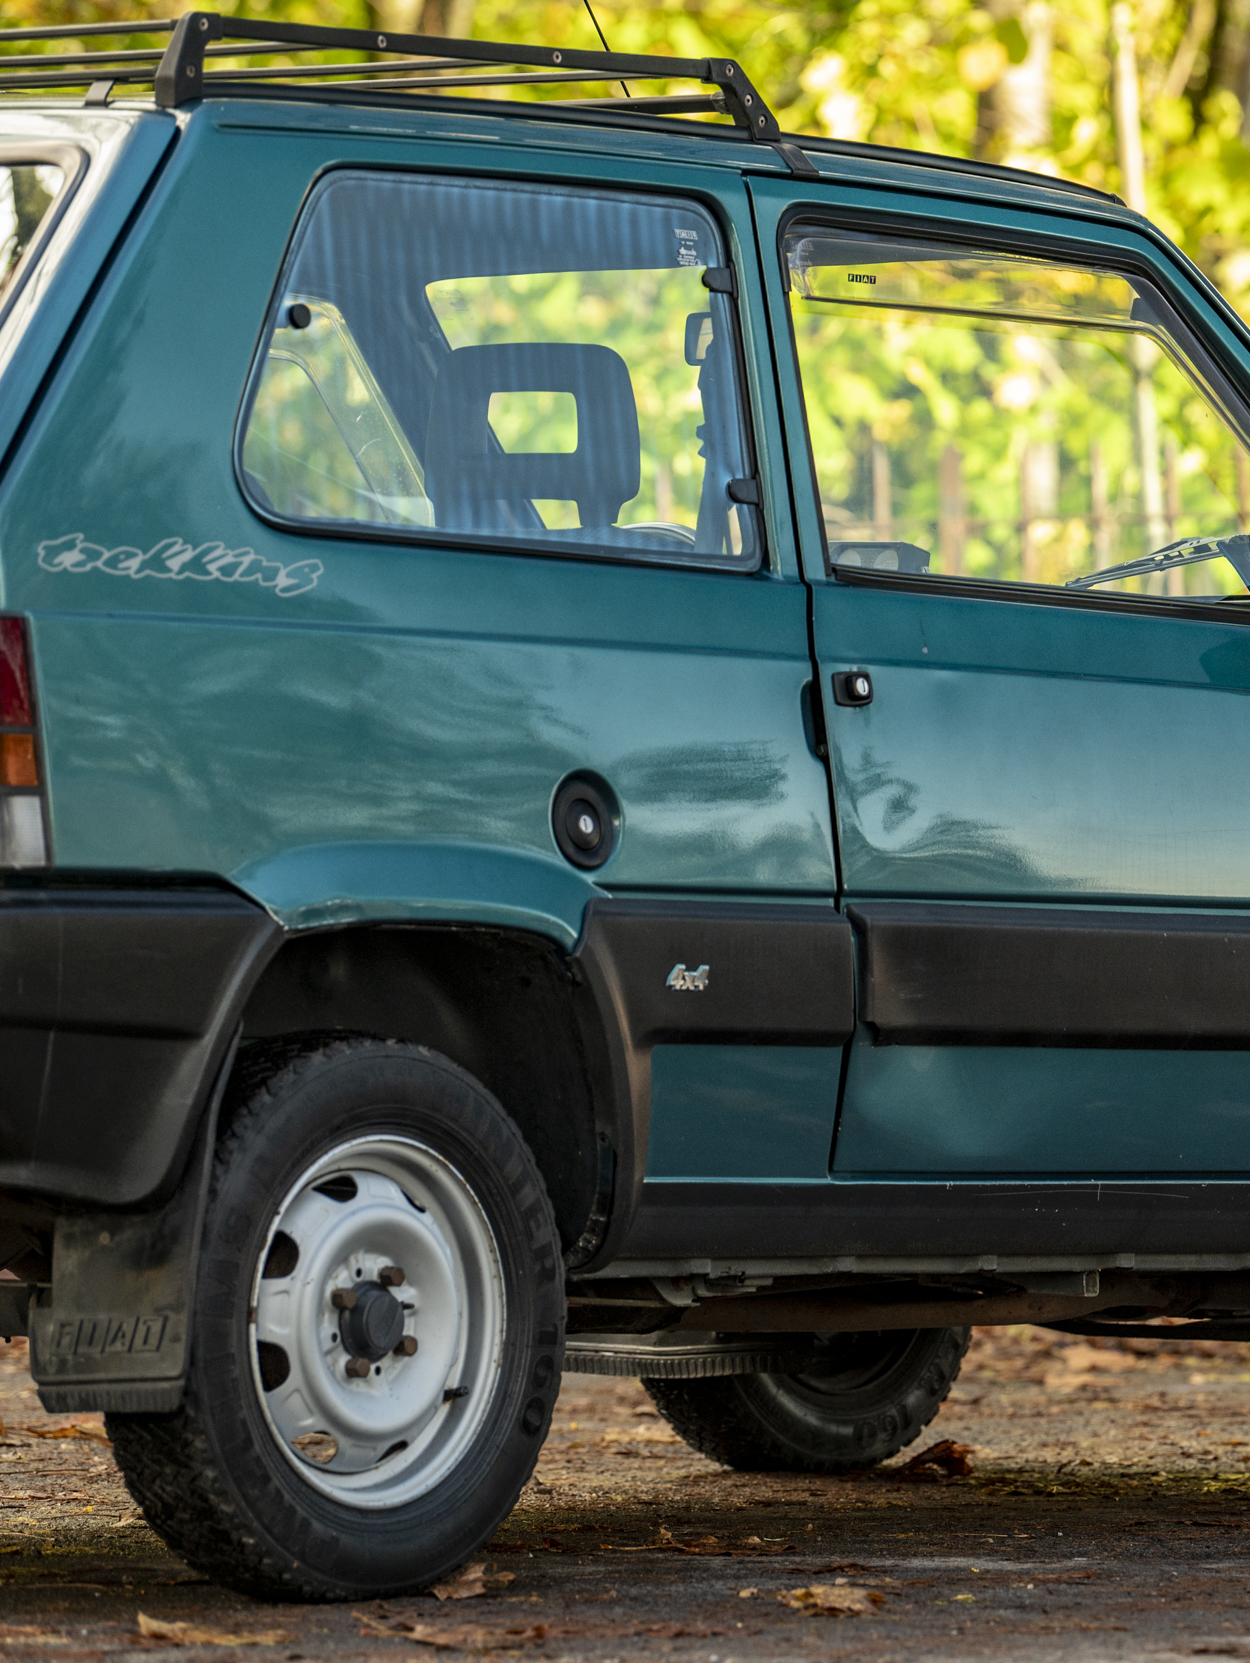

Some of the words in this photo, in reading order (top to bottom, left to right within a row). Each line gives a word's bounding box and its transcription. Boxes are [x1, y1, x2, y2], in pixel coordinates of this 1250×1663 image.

[848, 273, 876, 284] FIAT
[55, 1316, 168, 1354] FIAT
[523, 1321, 560, 1438] 160
